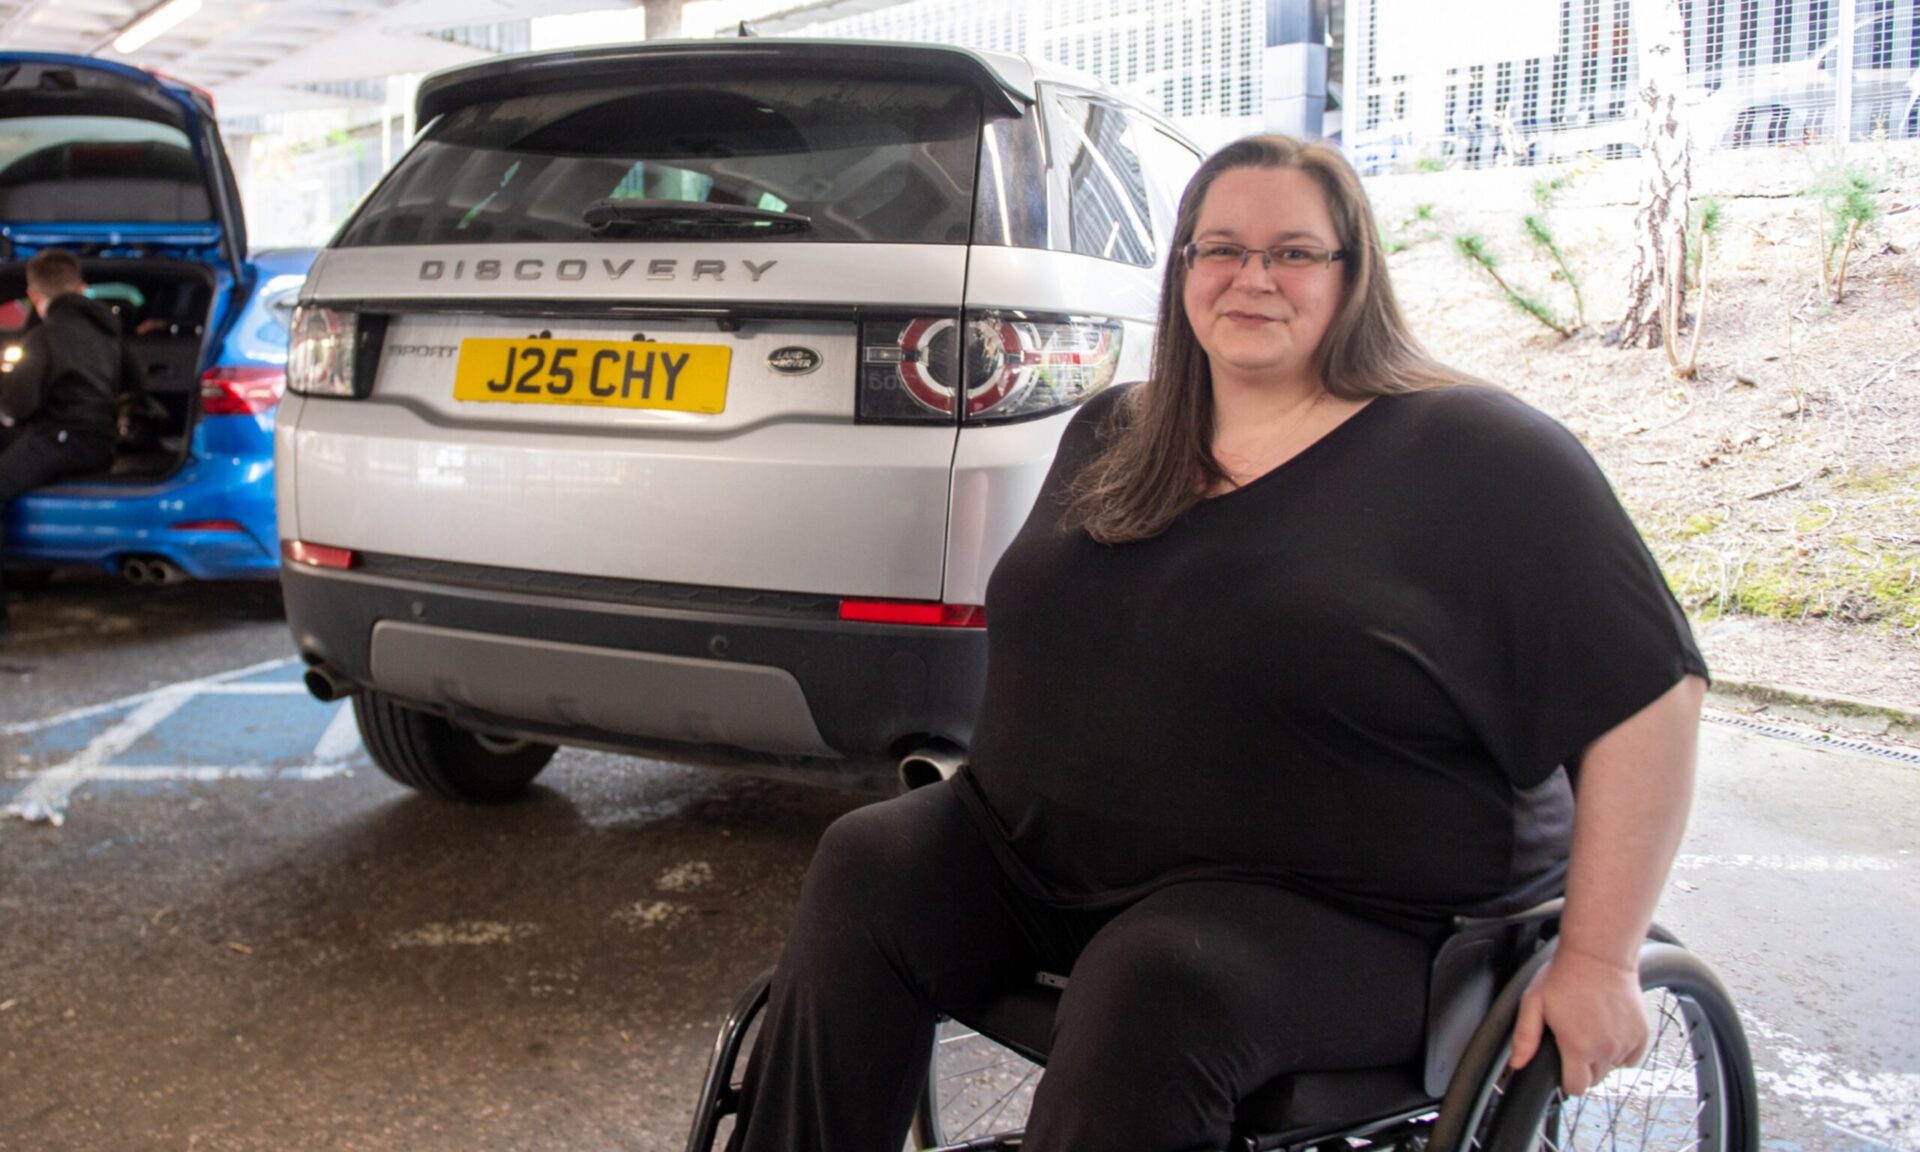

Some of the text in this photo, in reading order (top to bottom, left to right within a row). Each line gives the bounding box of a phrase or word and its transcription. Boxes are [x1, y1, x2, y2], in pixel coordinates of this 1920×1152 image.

[418, 259, 778, 282] DISCOVERY
[388, 344, 459, 358] SPORT
[486, 347, 690, 401] J25 CHY
